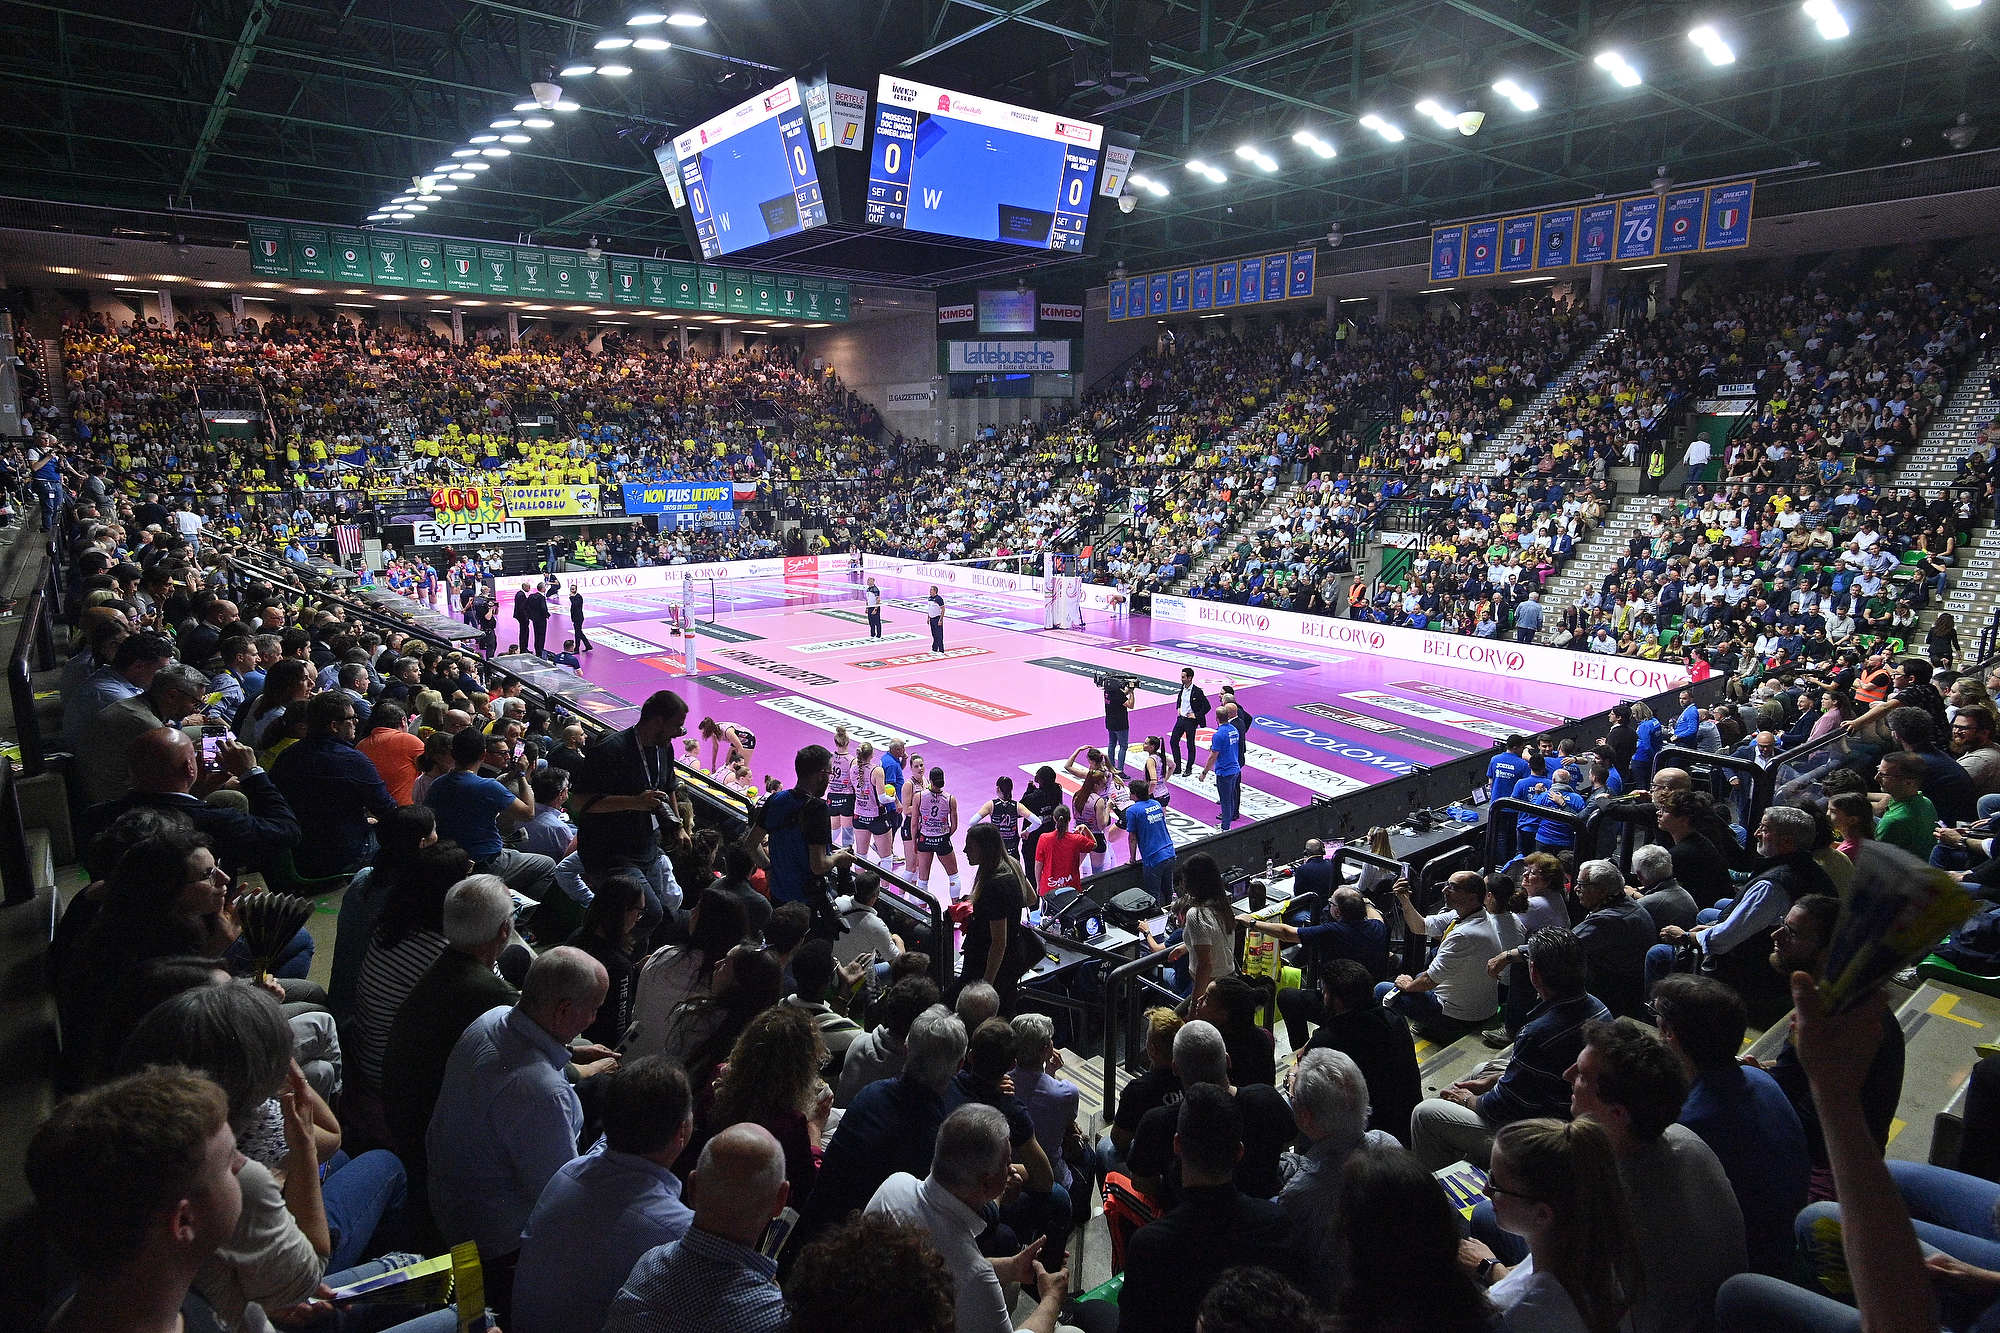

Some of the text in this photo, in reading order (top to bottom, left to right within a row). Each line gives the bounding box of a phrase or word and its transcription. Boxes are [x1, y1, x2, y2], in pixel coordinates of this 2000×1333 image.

[794, 146, 807, 176] 0
[885, 143, 900, 174] 0
[798, 188, 817, 203] SET 0
[872, 188, 902, 202] SET 0
[924, 187, 943, 210] W
[1069, 179, 1082, 206] 0
[693, 188, 704, 213] 0
[869, 204, 885, 214] TIME
[719, 212, 731, 232] W
[869, 214, 884, 223] OUT
[1057, 217, 1081, 230] SET 0
[1053, 232, 1067, 241] TIME
[1624, 218, 1652, 244] 76
[1053, 241, 1065, 249] OUT
[939, 308, 973, 320] KIMBO
[1041, 307, 1082, 317] KIMBO
[964, 342, 1054, 365] lattebusche
[895, 392, 929, 401] GAZZETTINO
[430, 488, 479, 512] 400
[643, 487, 729, 503] NON PLUS ULTRA'S
[719, 512, 735, 520] CURA
[1423, 639, 1525, 672] BELCORVO
[931, 805, 939, 817] 8
